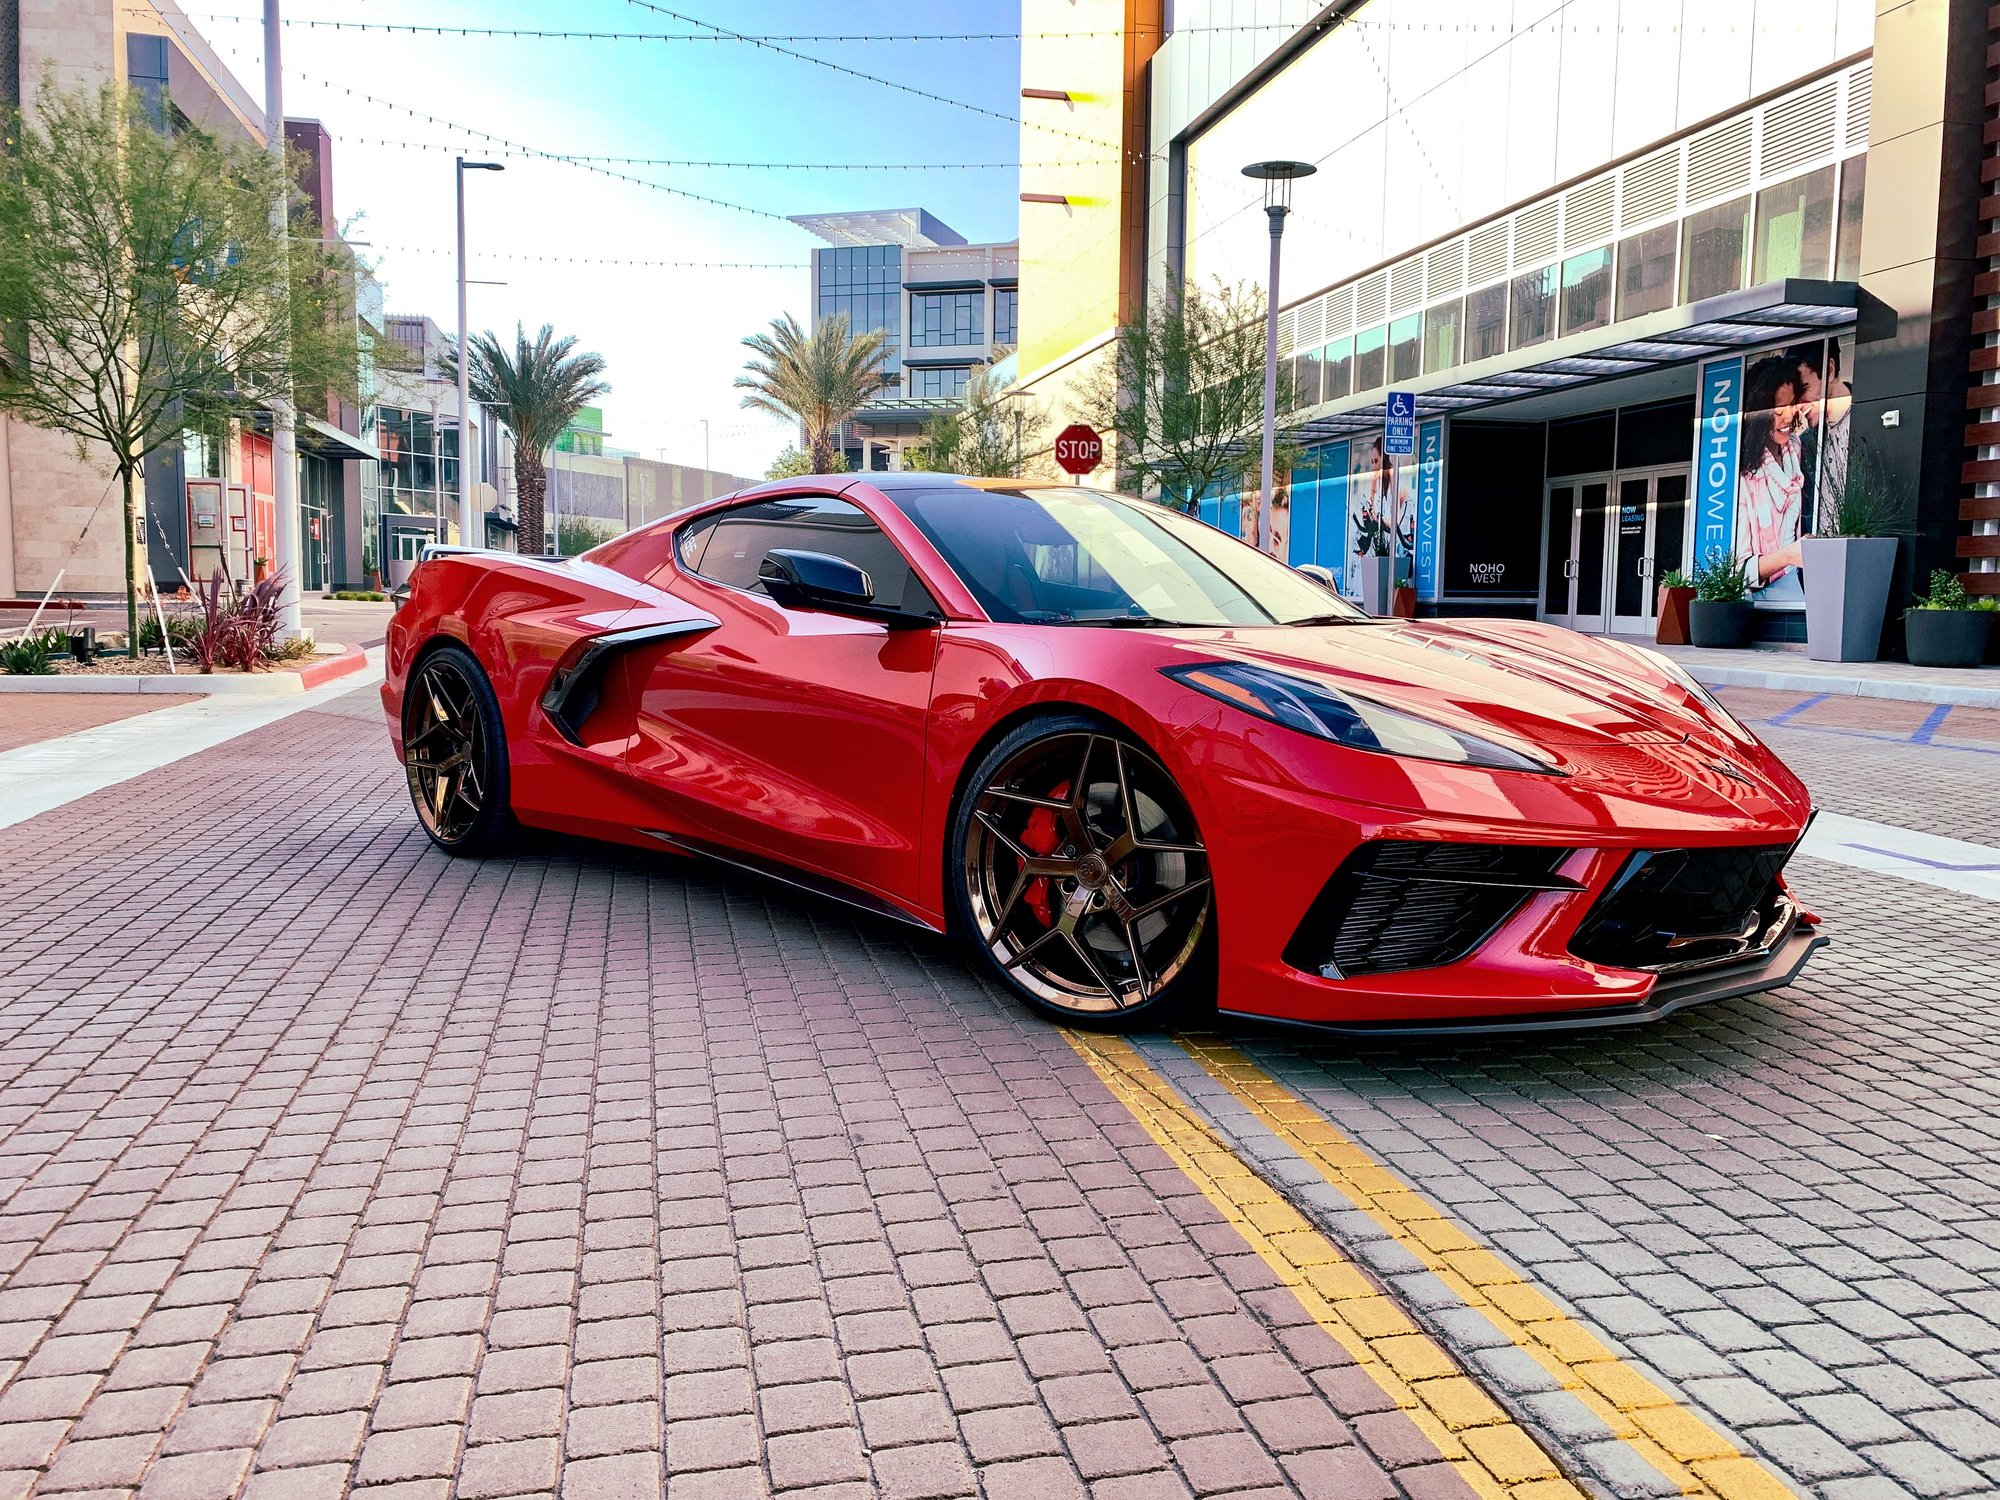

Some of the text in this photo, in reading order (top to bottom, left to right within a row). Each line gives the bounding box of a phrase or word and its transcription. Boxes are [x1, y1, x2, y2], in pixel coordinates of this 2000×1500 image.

[1388, 416, 1413, 427] PARKING
[1392, 426, 1408, 436] ONLY
[1058, 440, 1100, 459] STOP
[1705, 379, 1731, 561] NOHOWES
[1420, 436, 1436, 583] NOHOWEST
[1622, 506, 1637, 514] NOW
[1621, 513, 1645, 522] LEASING
[1469, 563, 1506, 573] NOHO
[1471, 573, 1503, 584] WEST
